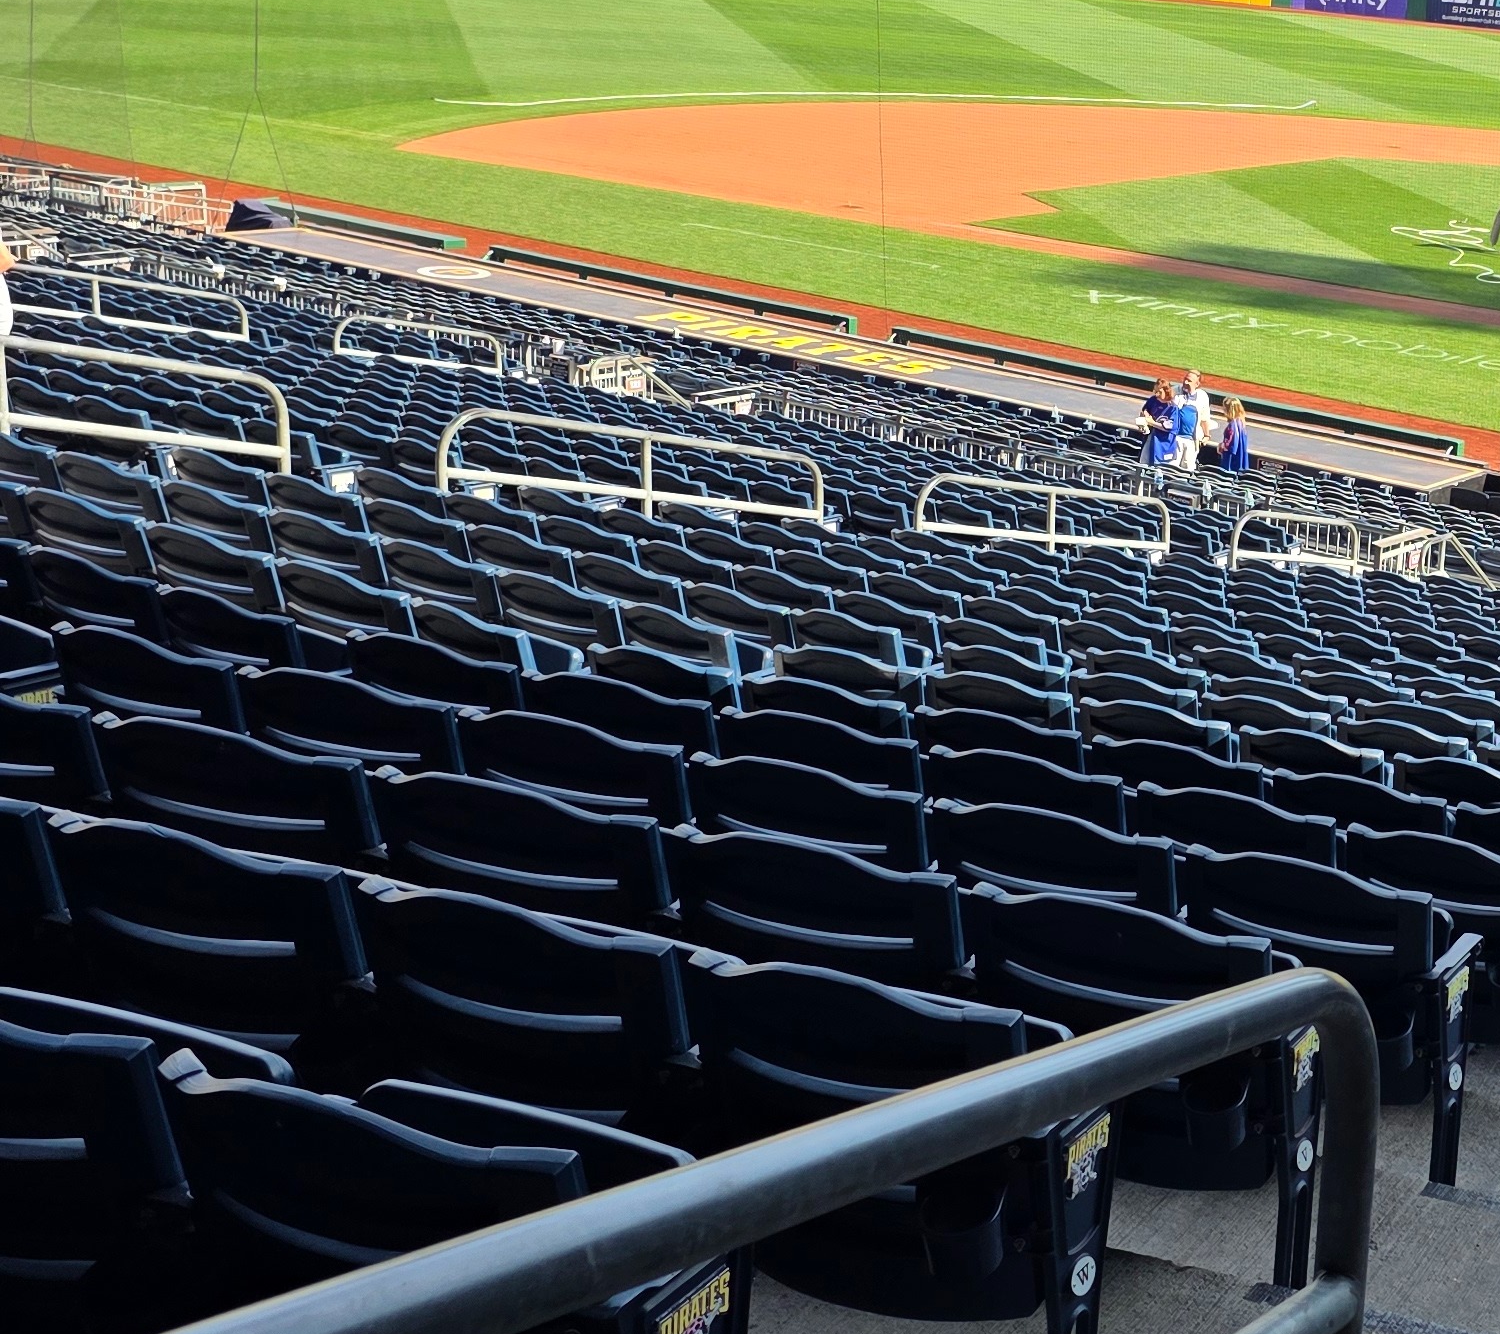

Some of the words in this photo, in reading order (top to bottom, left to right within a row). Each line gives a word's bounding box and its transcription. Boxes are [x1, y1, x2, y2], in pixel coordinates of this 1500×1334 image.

[633, 311, 952, 375] PIRATES
[1066, 1112, 1111, 1181] PIRATES
[1076, 1262, 1090, 1286] W
